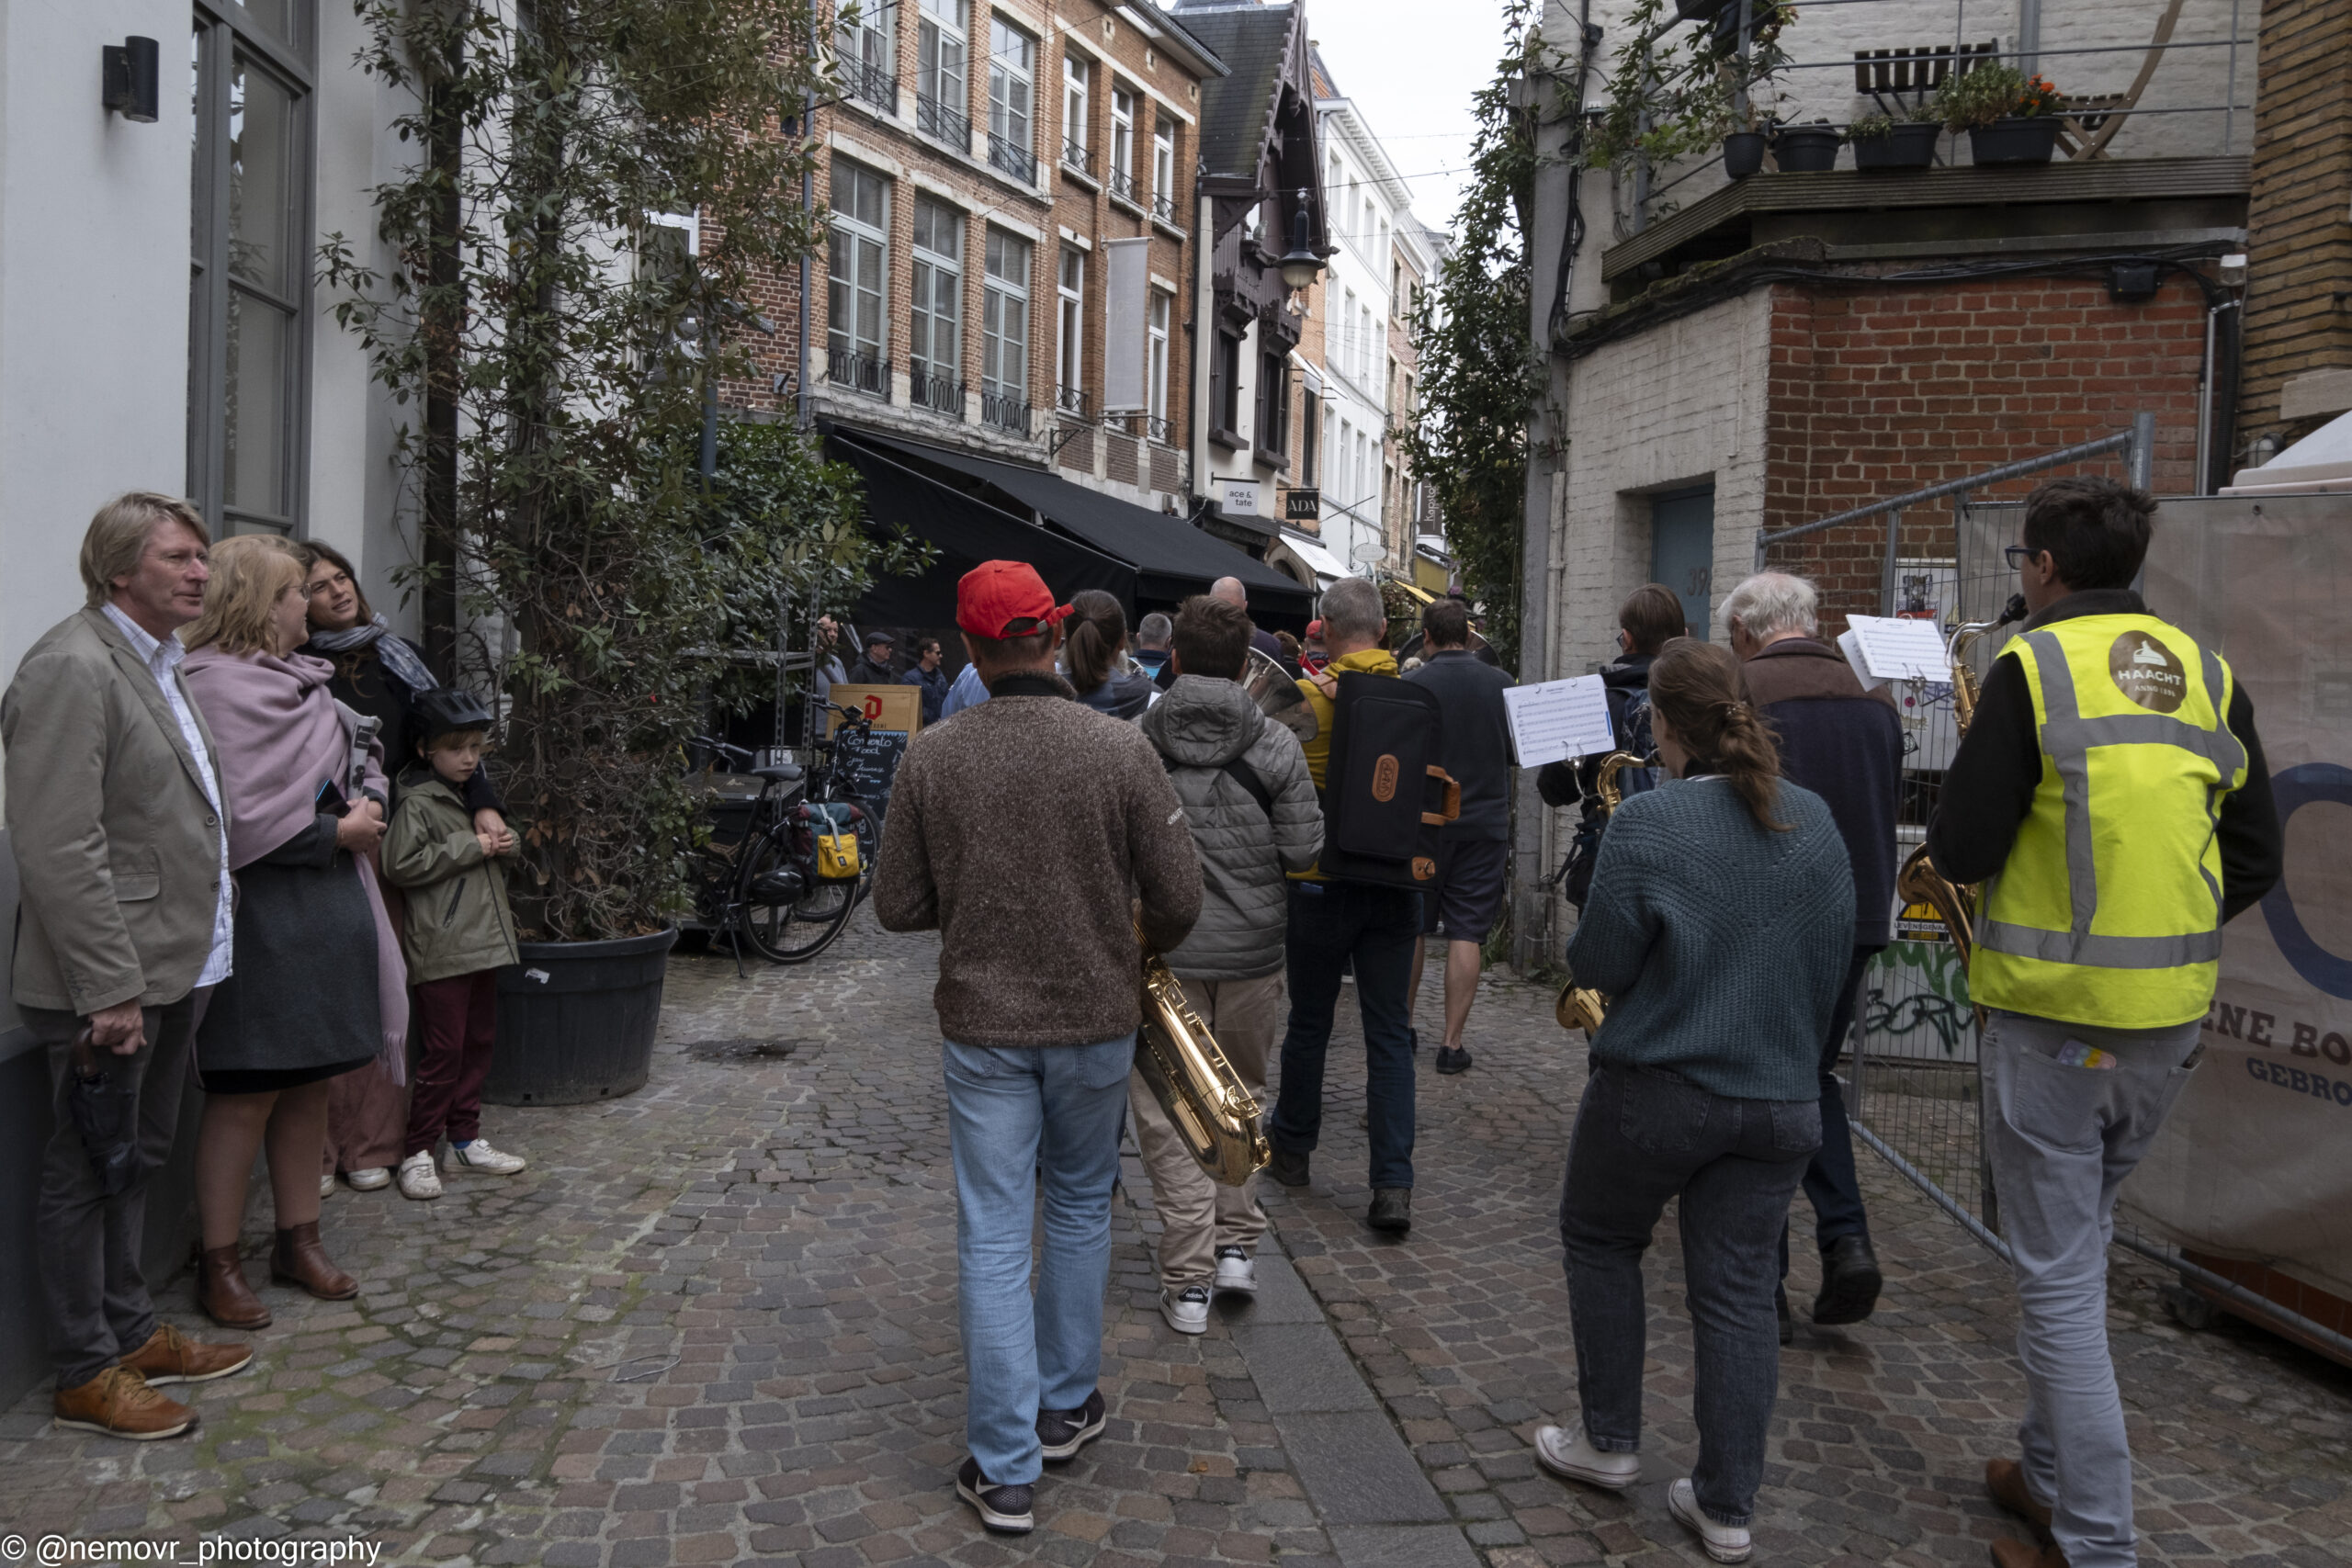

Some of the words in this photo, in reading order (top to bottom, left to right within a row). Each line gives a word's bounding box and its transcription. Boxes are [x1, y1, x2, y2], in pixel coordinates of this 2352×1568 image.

[1246, 491, 1252, 499] &
[1235, 499, 1252, 507] tate
[1287, 500, 1317, 512] ADA
[2118, 670, 2182, 685] HAACHT
[1894, 921, 1949, 931] LEVENSGEVAA
